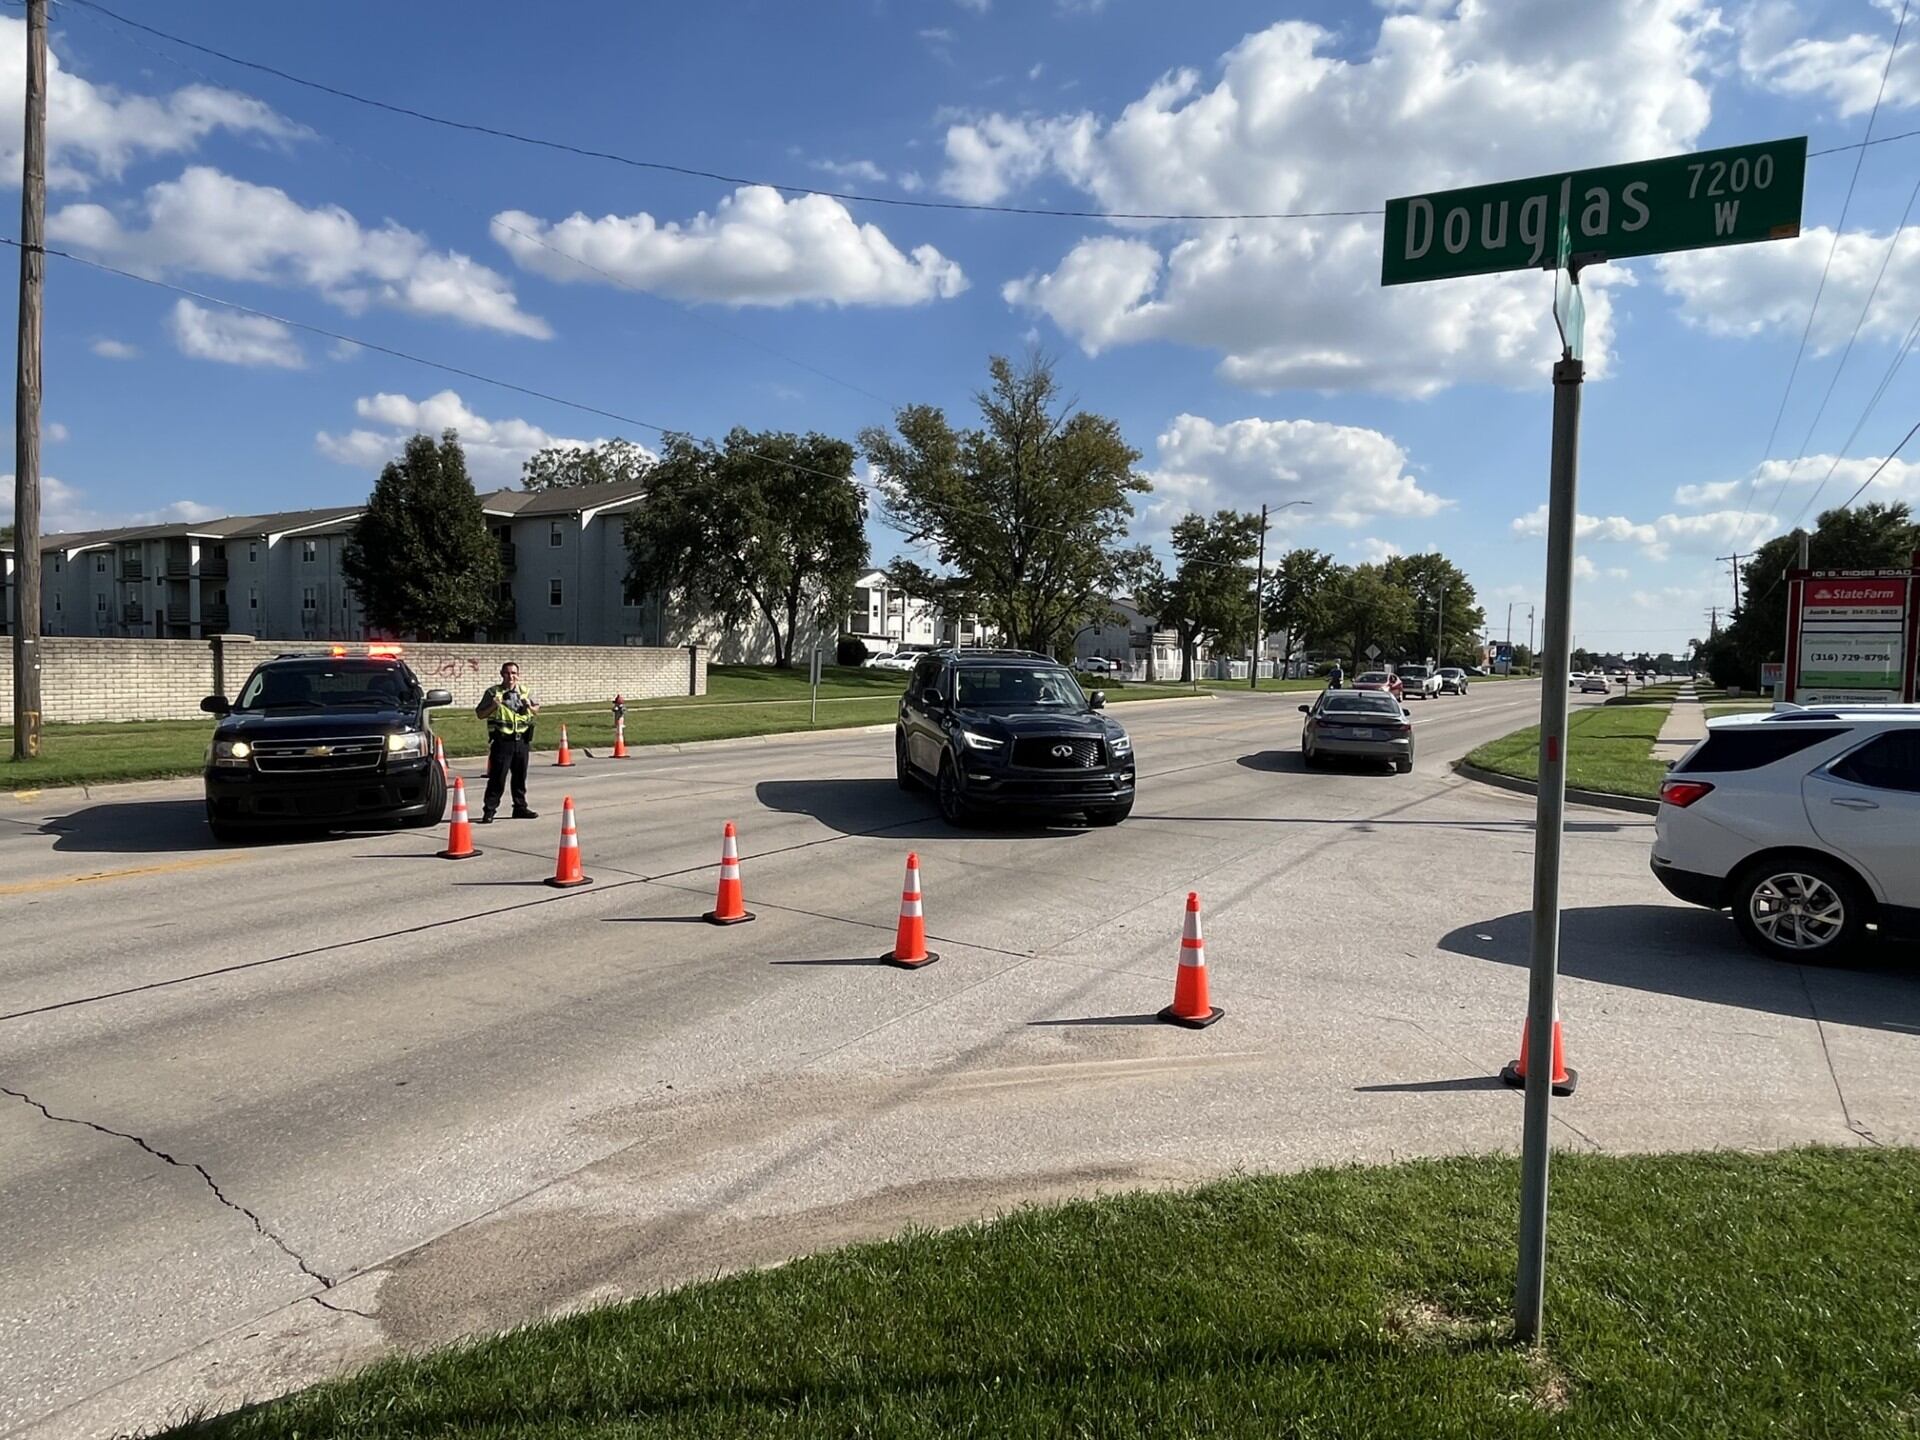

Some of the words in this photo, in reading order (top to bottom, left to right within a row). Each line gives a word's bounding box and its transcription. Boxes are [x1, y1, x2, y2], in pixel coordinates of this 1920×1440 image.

[1687, 153, 1774, 200] 7200
[1404, 176, 1651, 266] Douglas
[1714, 200, 1741, 237] W
[1841, 569, 1876, 577] RIDGE
[1810, 652, 1839, 662] (316)
